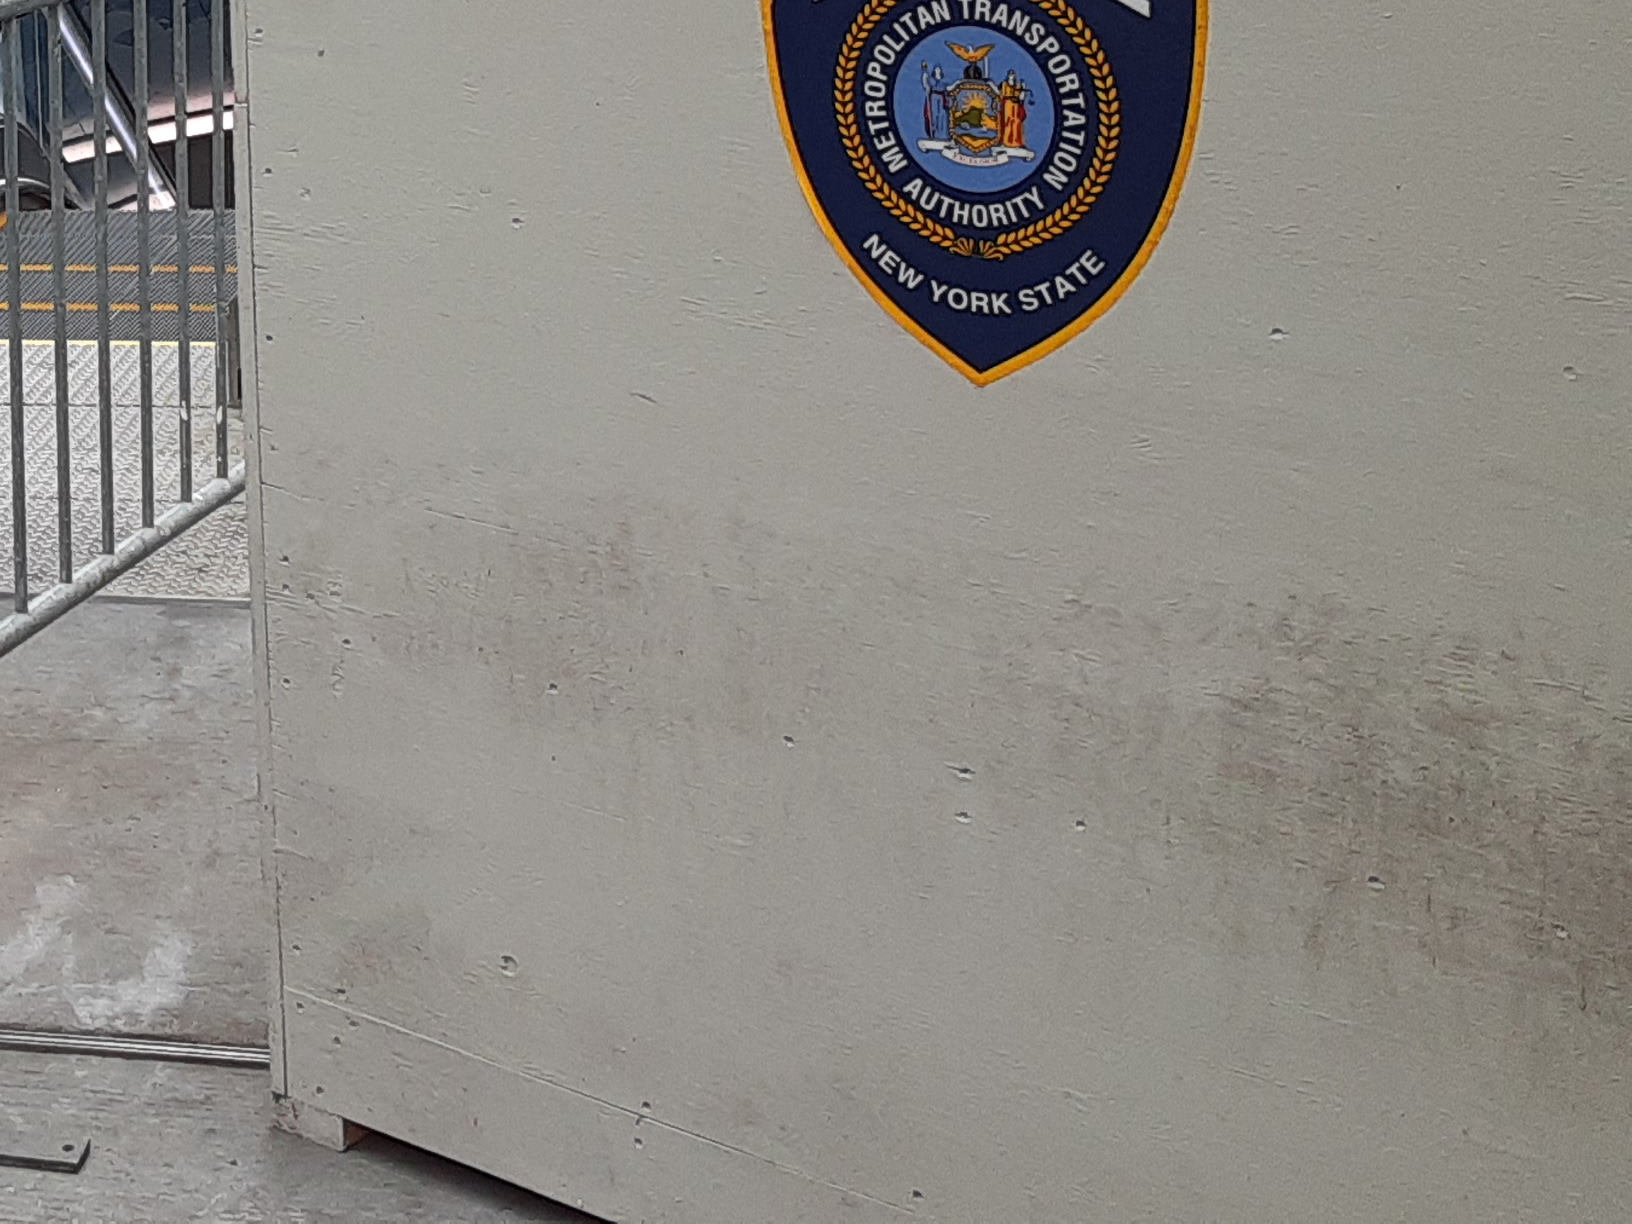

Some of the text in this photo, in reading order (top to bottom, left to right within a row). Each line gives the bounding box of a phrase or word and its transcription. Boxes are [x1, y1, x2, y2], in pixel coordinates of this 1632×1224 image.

[902, 178, 1045, 228] AUTHORITY
[863, 233, 1106, 314] NEW YORK STATE
